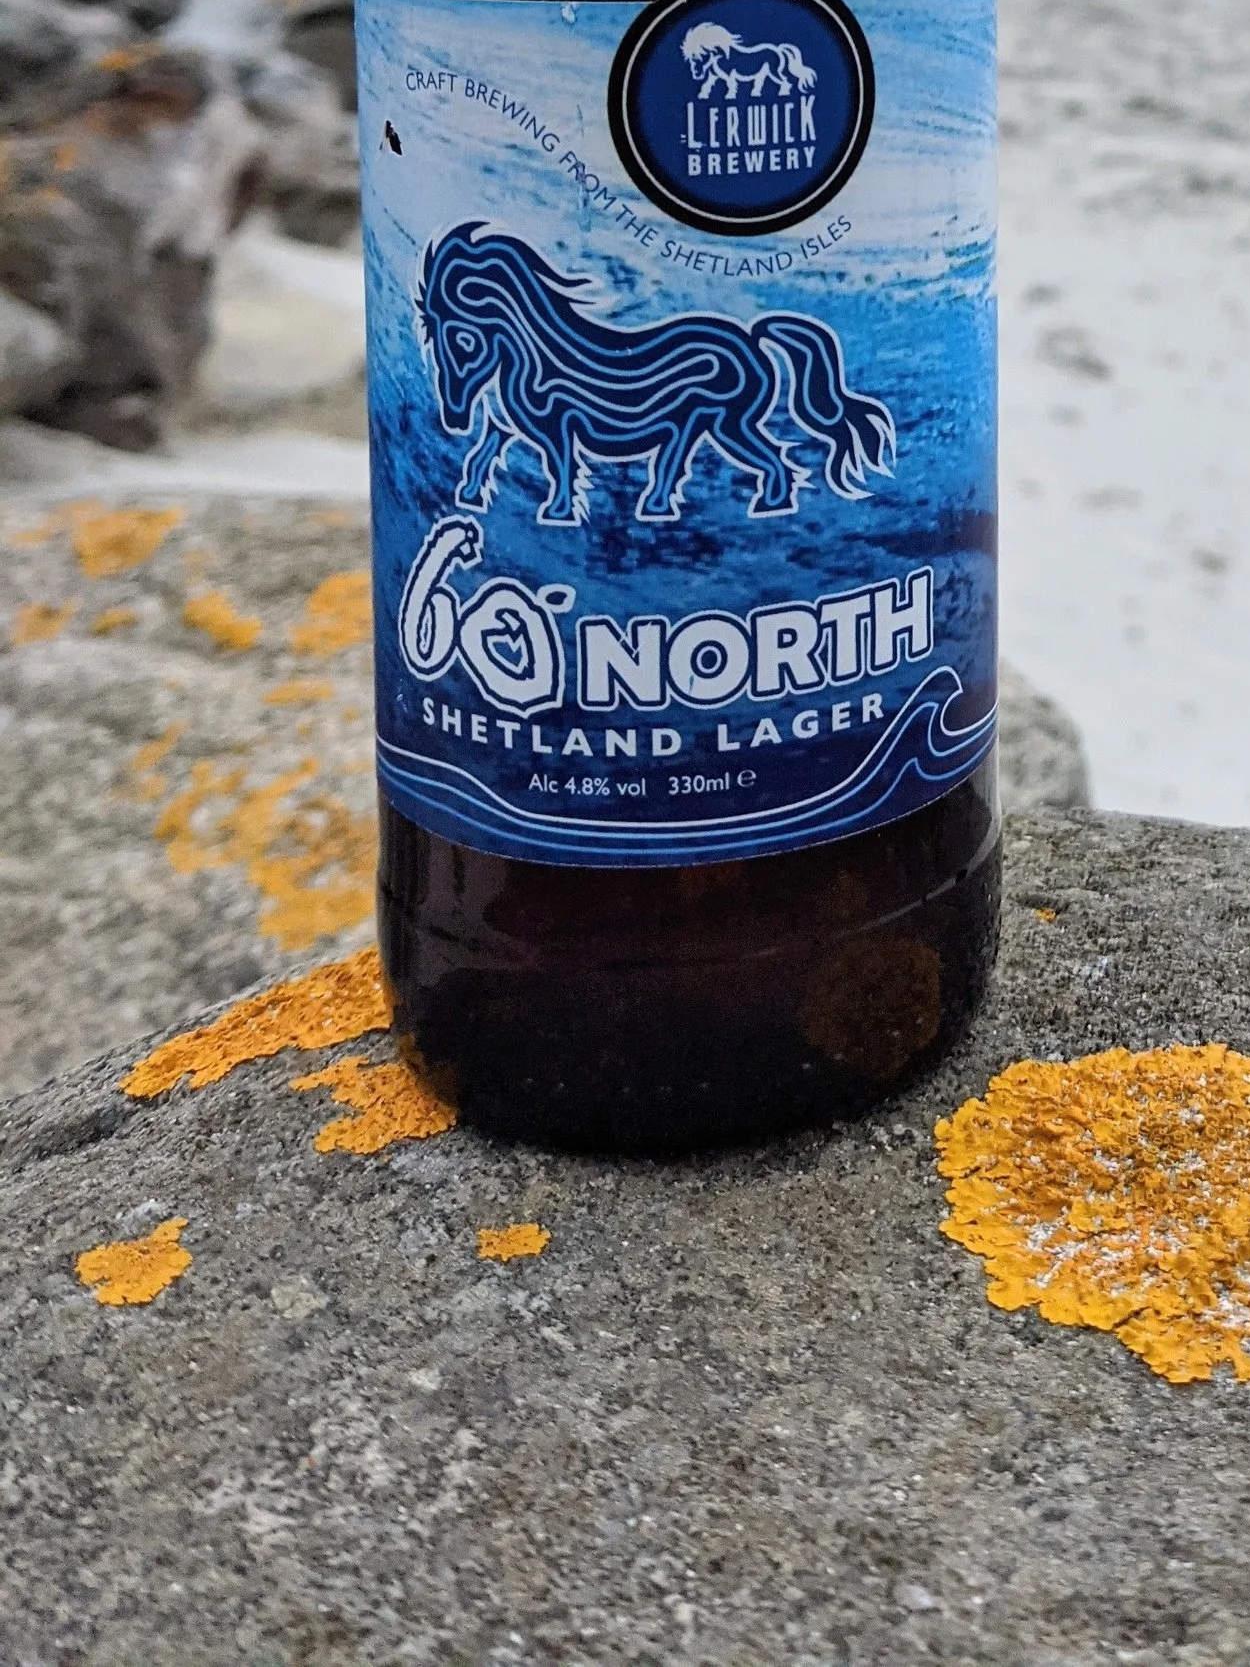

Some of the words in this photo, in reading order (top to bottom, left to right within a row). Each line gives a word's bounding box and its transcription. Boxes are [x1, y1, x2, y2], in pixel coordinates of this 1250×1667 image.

[685, 94, 818, 149] LERWICK
[405, 68, 458, 92] CRAFT
[464, 78, 562, 154] BREWING
[559, 150, 617, 209] FROM
[615, 203, 659, 247] THE
[660, 240, 794, 278] SHETLAND
[799, 214, 853, 262] ISLES
[687, 145, 816, 177] BREWERY
[577, 565, 934, 712] NORTH
[422, 696, 682, 758] SHETLAND
[717, 692, 886, 753] LAGER
[529, 772, 560, 795] Alc
[564, 775, 611, 798] 4.8%
[616, 775, 648, 798] vol
[667, 772, 732, 796] 330ml
